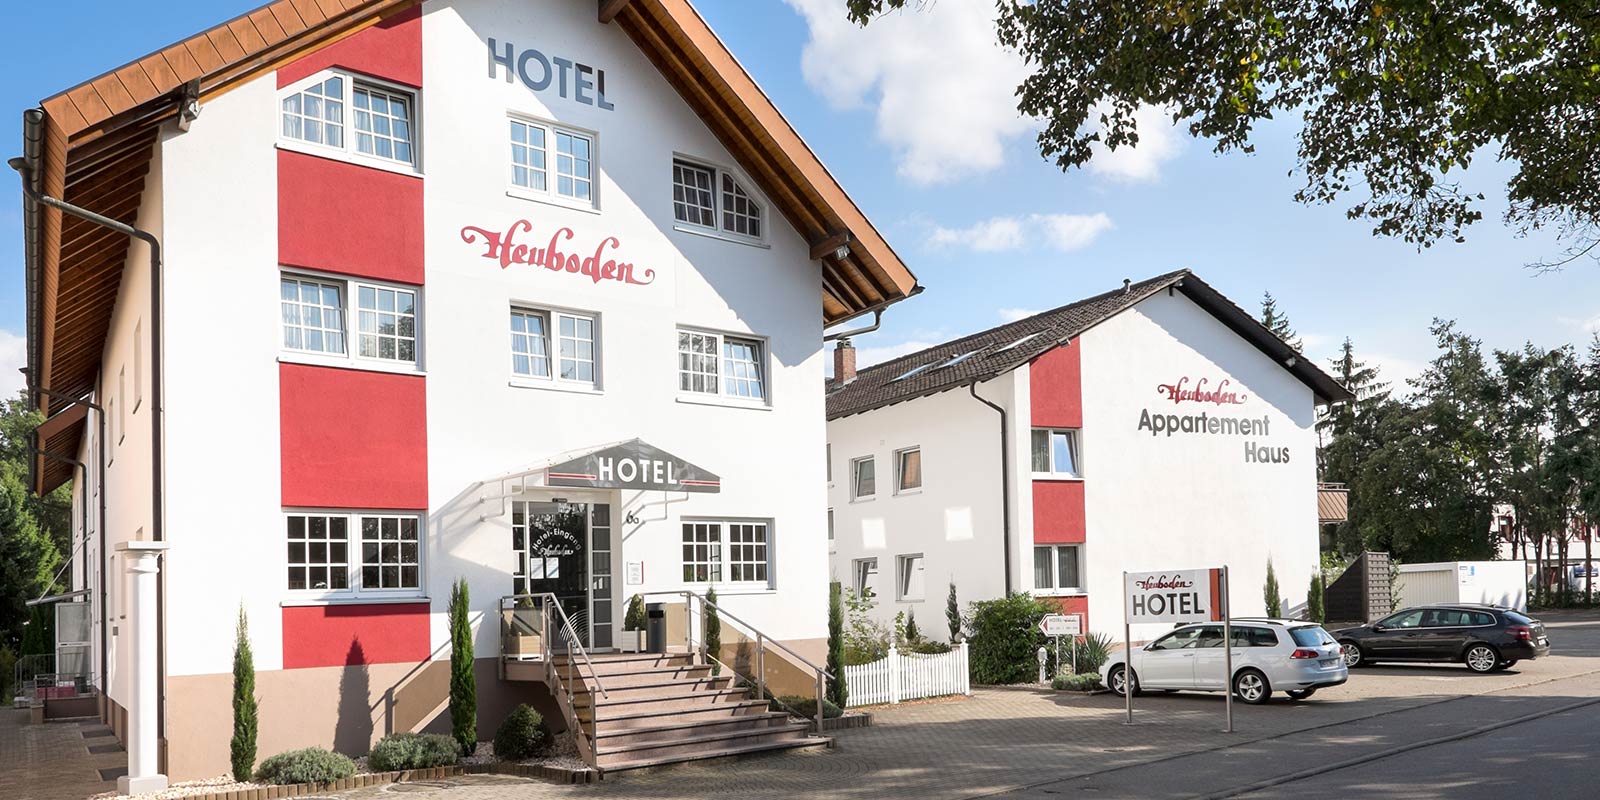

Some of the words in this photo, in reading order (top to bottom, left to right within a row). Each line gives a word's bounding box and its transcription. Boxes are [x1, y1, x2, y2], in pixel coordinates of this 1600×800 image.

[488, 37, 615, 111] HOTEL
[460, 219, 655, 285] Heuboden
[1157, 376, 1247, 406] Heuboden
[1138, 408, 1270, 437] Appartement
[1244, 441, 1290, 463] Haus
[599, 456, 678, 485] HOTEL
[532, 528, 581, 551] Hotel-Eingang
[1135, 574, 1193, 591] Heuboden
[1132, 592, 1205, 616] HOTEL
